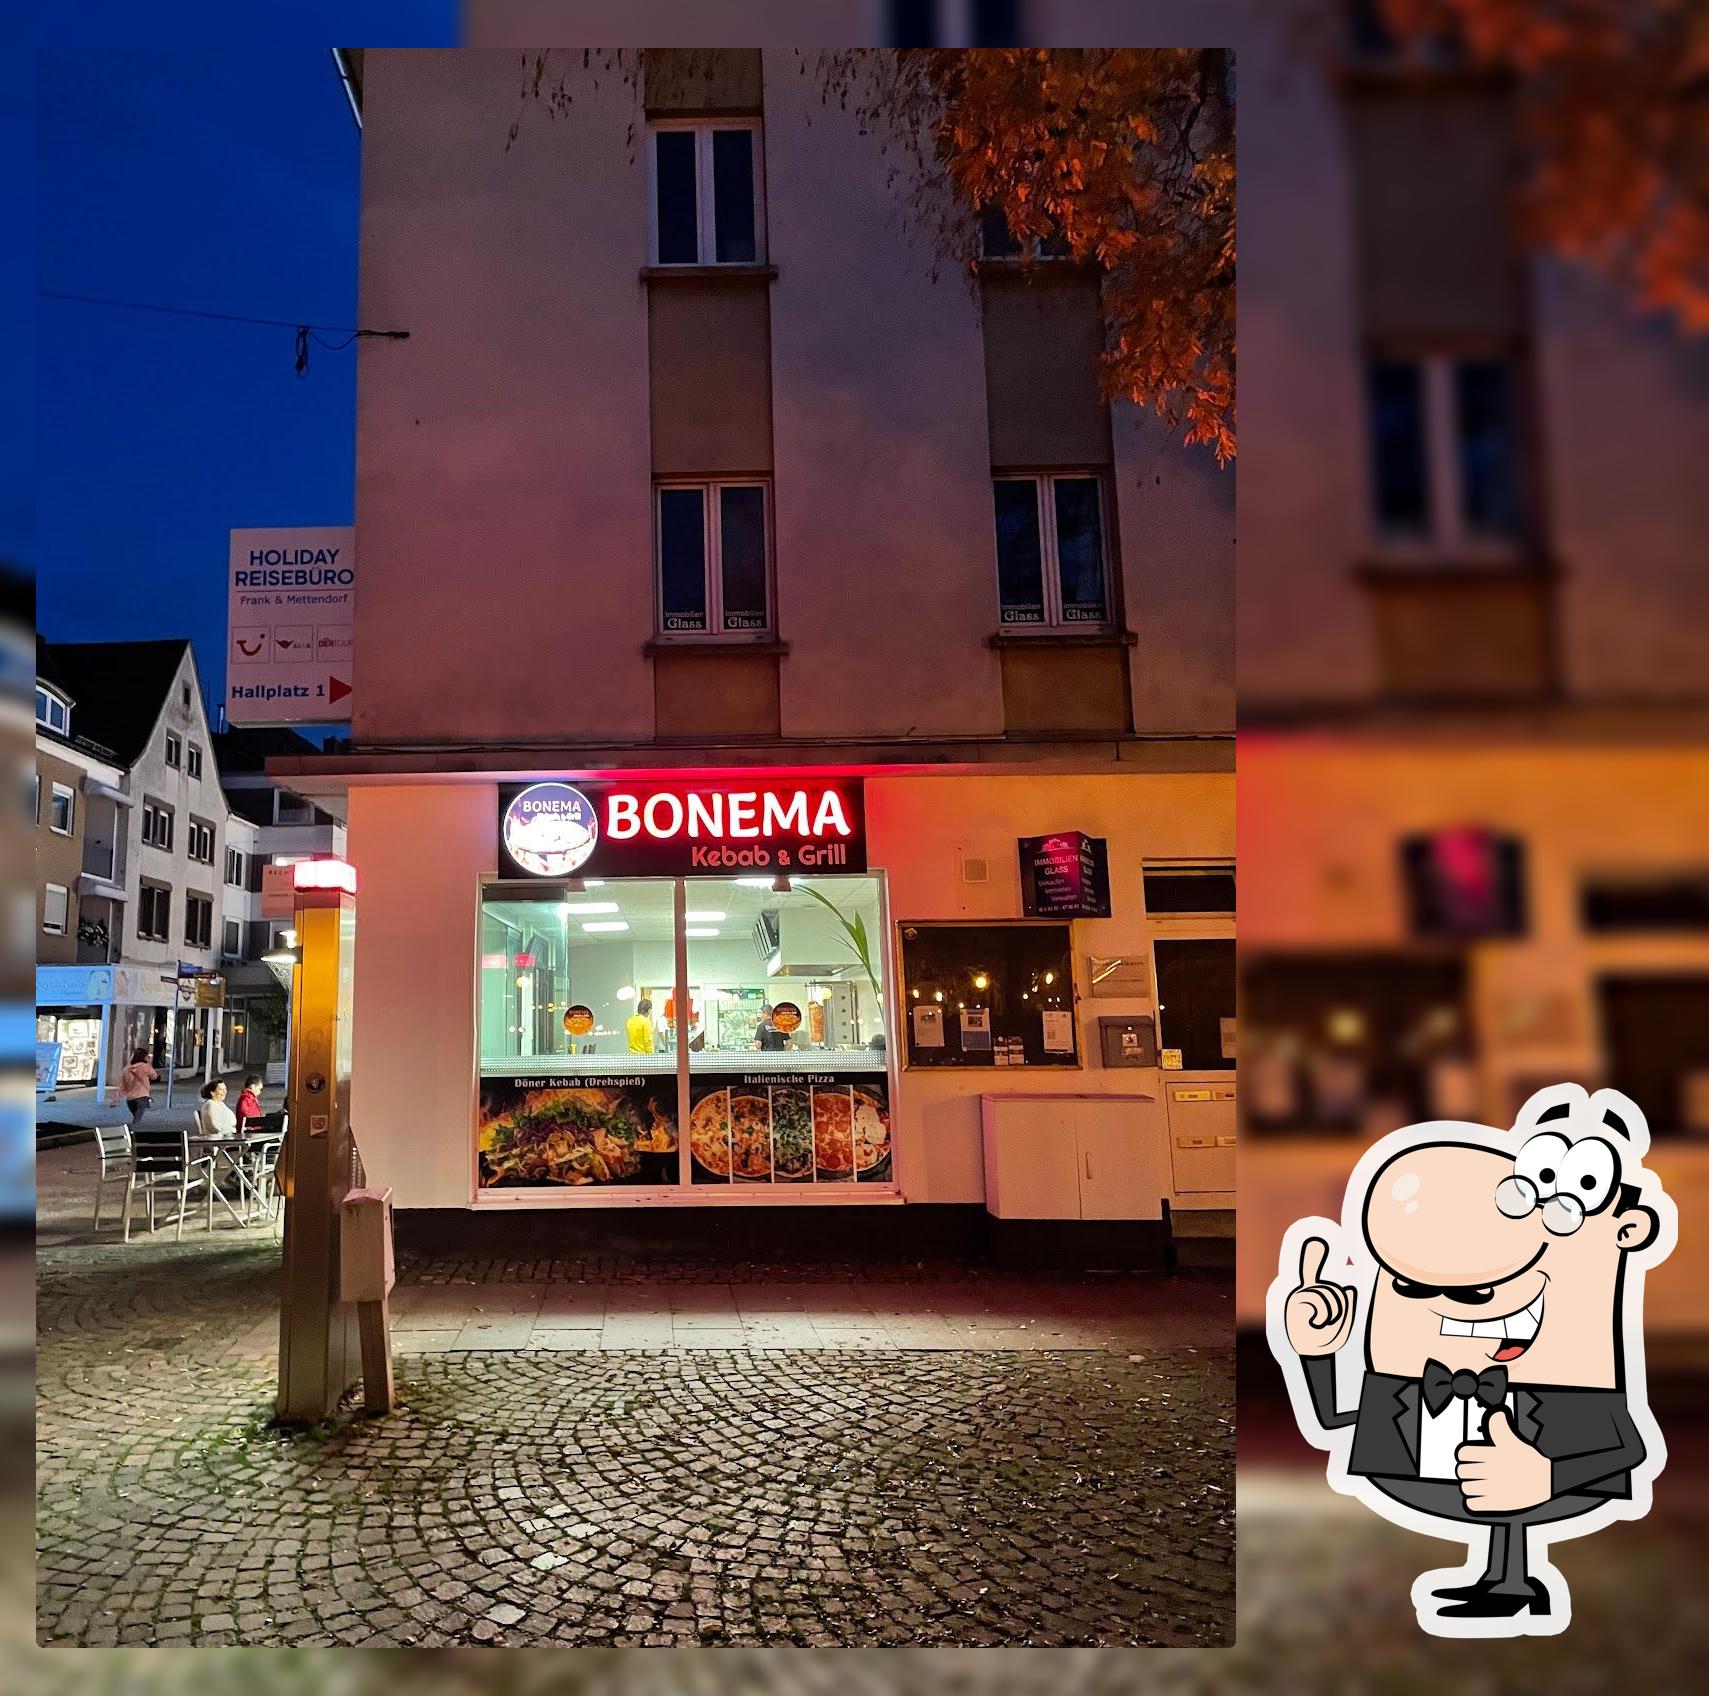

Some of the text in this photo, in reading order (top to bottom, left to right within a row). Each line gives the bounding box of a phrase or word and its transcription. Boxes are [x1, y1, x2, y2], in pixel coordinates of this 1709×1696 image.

[250, 549, 340, 566] HOLIDAY
[235, 568, 354, 587] REISEBÜRO
[240, 594, 348, 605] Frank & Mettendorf
[1003, 610, 1040, 622] Glass
[1066, 609, 1103, 620] Glass
[667, 618, 703, 629] Glass
[727, 617, 762, 628] Glass
[231, 685, 325, 701] Hallplatz 1
[522, 800, 582, 814] BONEMA
[606, 790, 852, 840] BONEMA
[692, 843, 846, 868] Kebab & Grill
[1034, 854, 1079, 867] IMMOBILIEN
[1044, 865, 1069, 875] GLASS
[514, 1076, 646, 1088] Döner Kebab (Drehspieß)
[744, 1073, 835, 1084] Italienische Pizza
